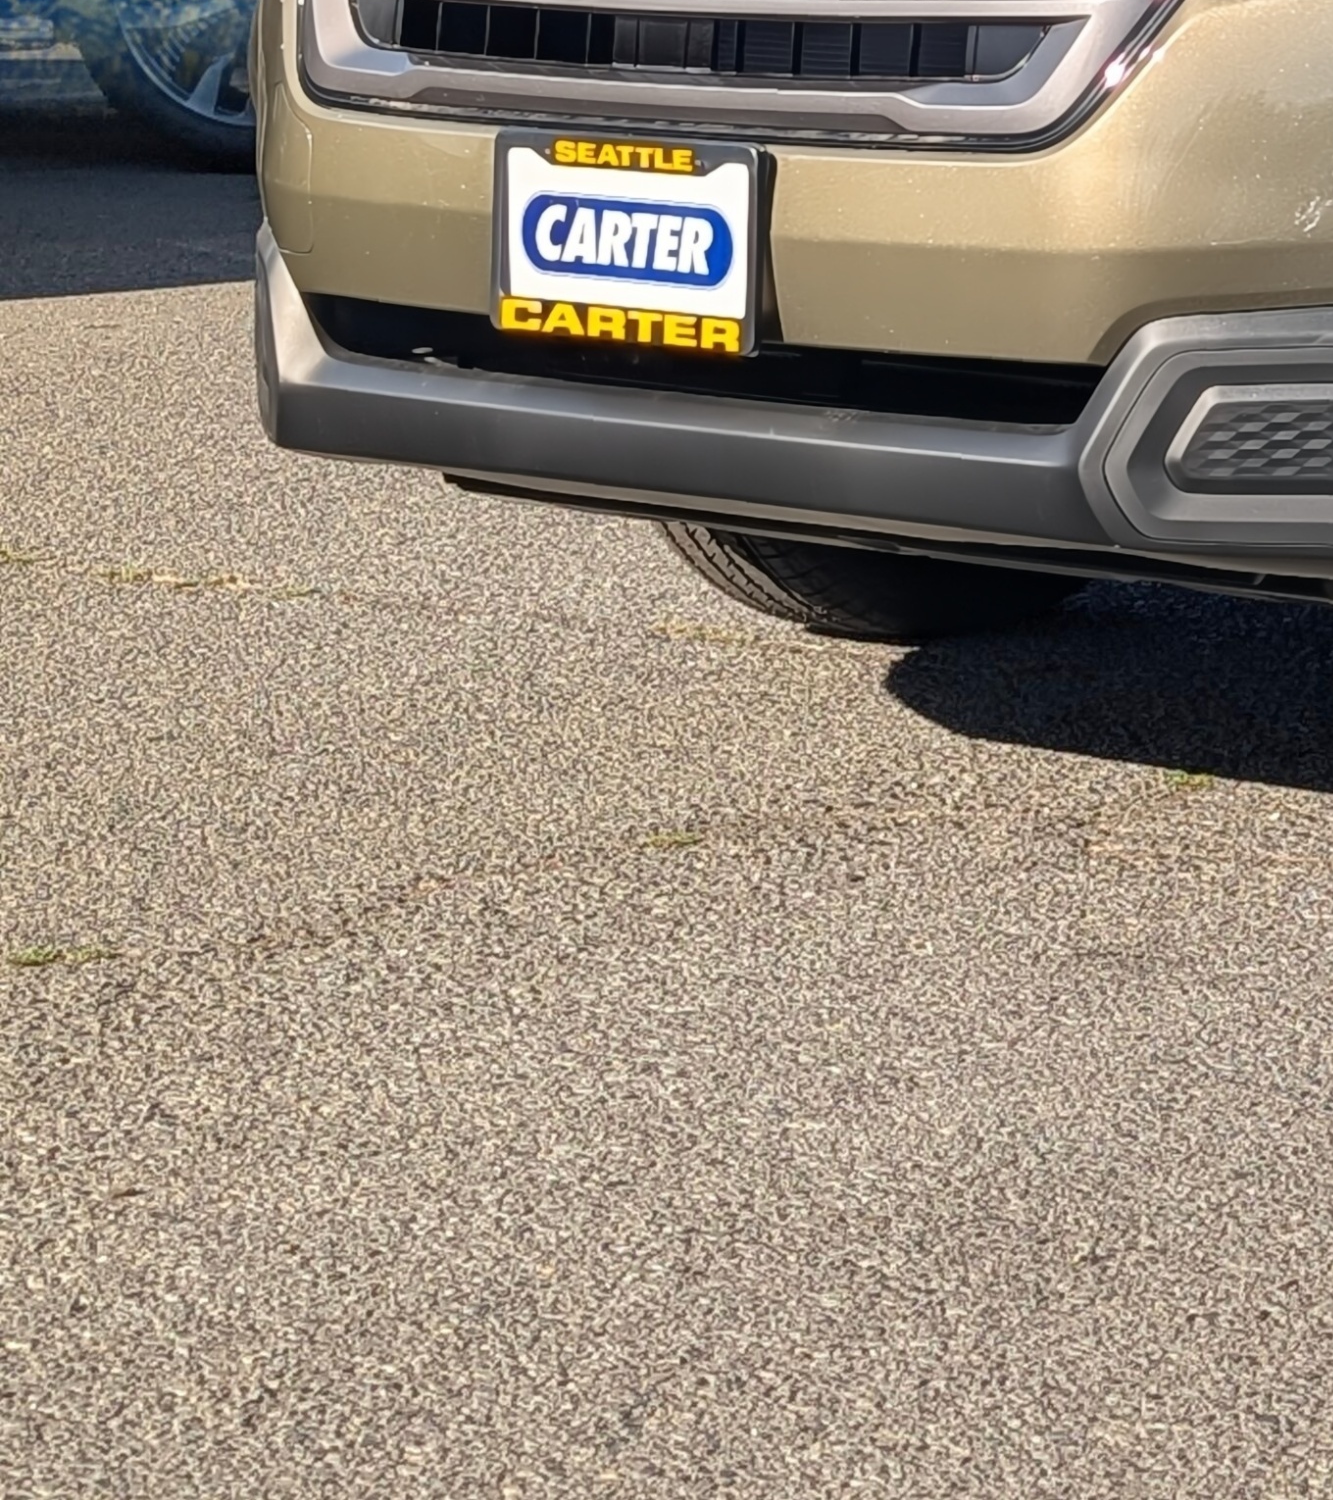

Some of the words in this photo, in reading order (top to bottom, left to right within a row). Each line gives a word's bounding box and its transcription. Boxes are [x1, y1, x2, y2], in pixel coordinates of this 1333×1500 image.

[554, 140, 693, 172] SEATTLE
[534, 203, 714, 275] CARTER
[500, 297, 740, 352] CARTER
